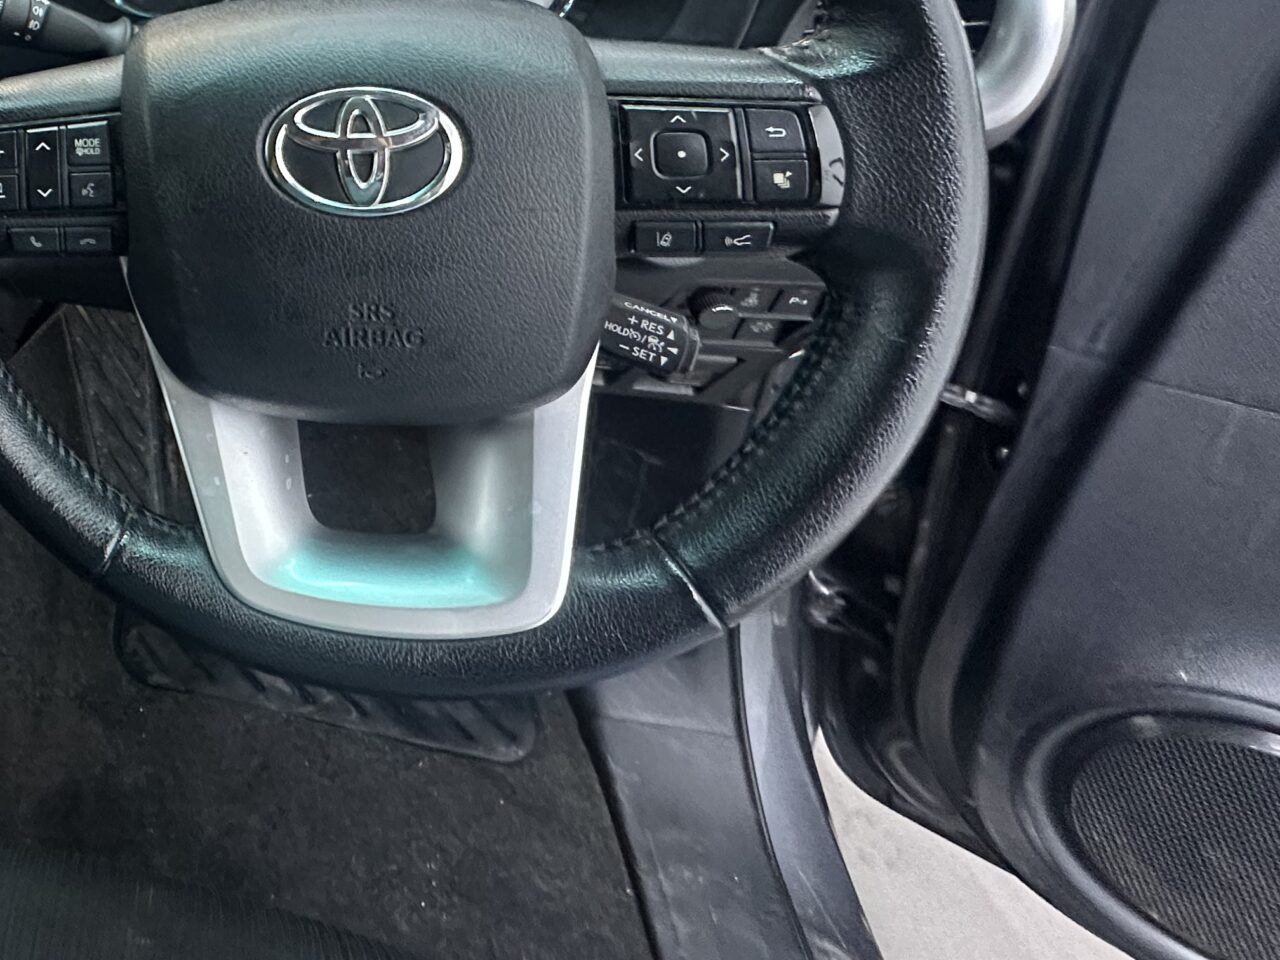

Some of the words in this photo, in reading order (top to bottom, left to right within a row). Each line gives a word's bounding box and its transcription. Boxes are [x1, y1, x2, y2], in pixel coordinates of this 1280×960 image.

[74, 138, 100, 148] MODE
[348, 303, 395, 322] SRS
[624, 301, 671, 322] CANCEL
[604, 320, 630, 337] HOLD
[640, 319, 665, 335] RES
[322, 326, 426, 349] AIRBAG
[632, 346, 657, 362] SET
